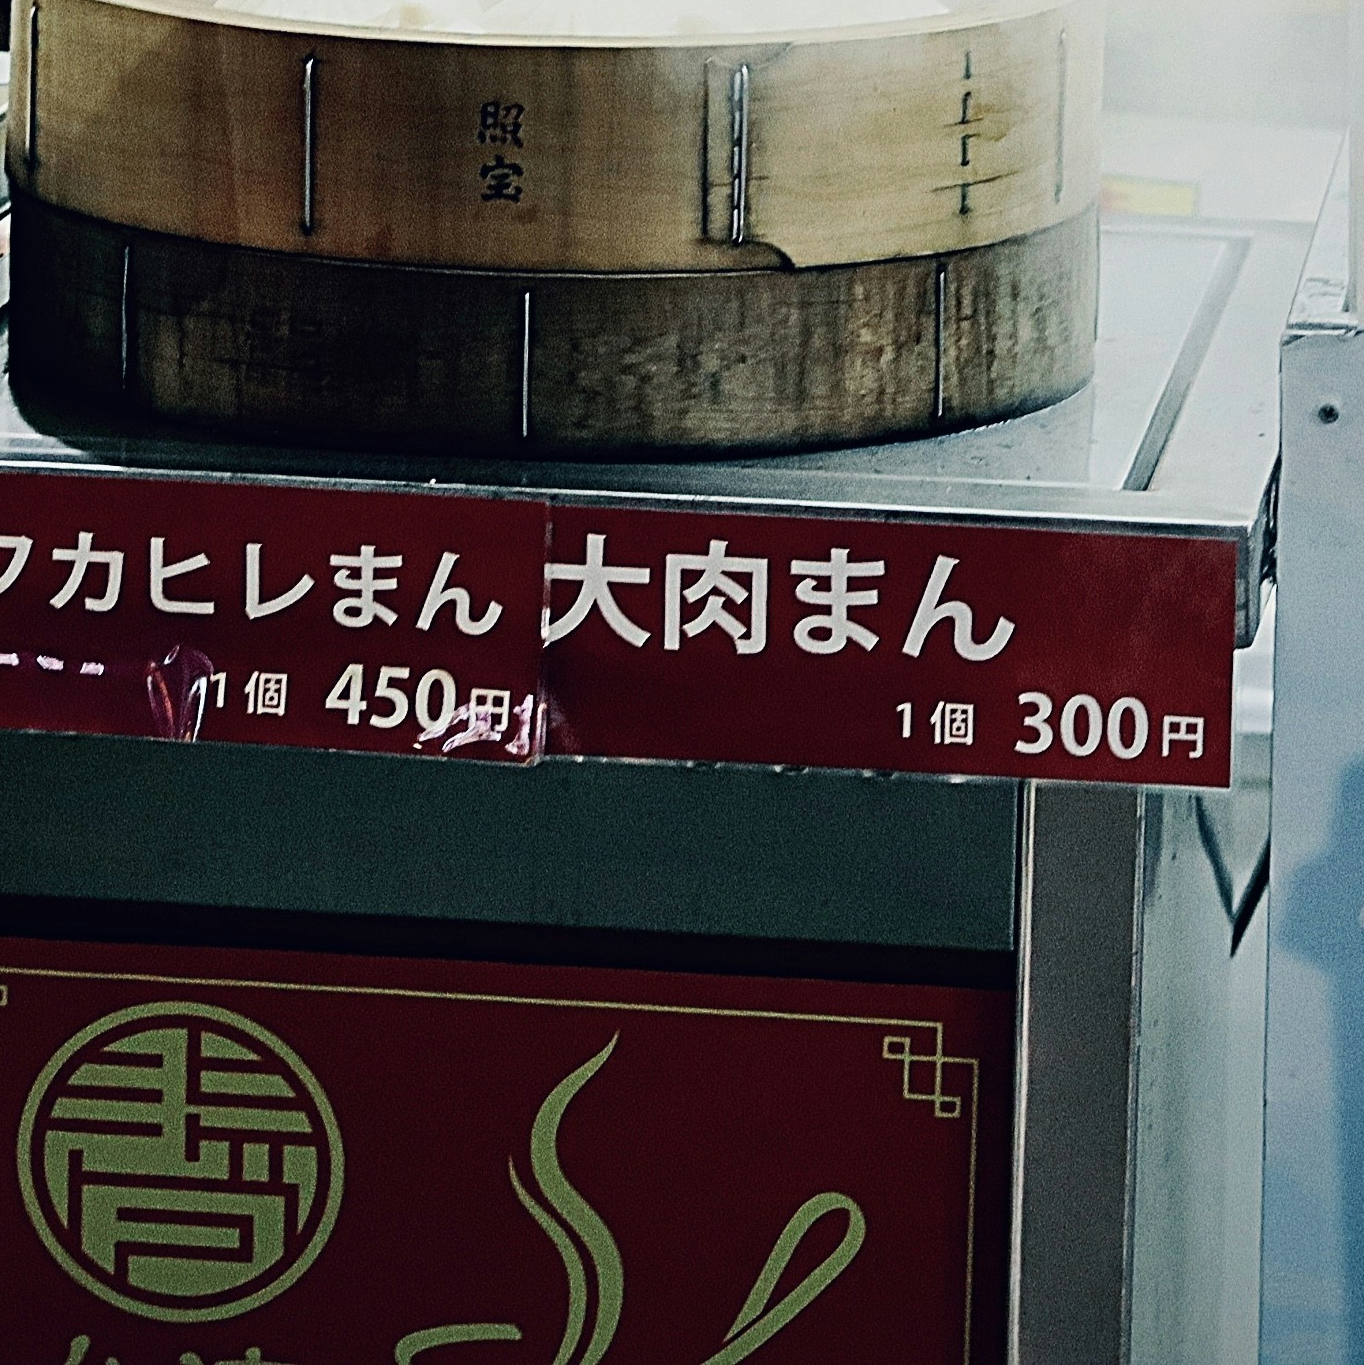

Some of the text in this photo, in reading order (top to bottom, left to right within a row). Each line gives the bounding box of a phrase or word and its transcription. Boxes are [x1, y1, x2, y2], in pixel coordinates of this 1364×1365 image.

[543, 533, 1015, 662] 大肉まん
[210, 663, 511, 733] 1個 450円
[896, 691, 1205, 760] 1個 300円
